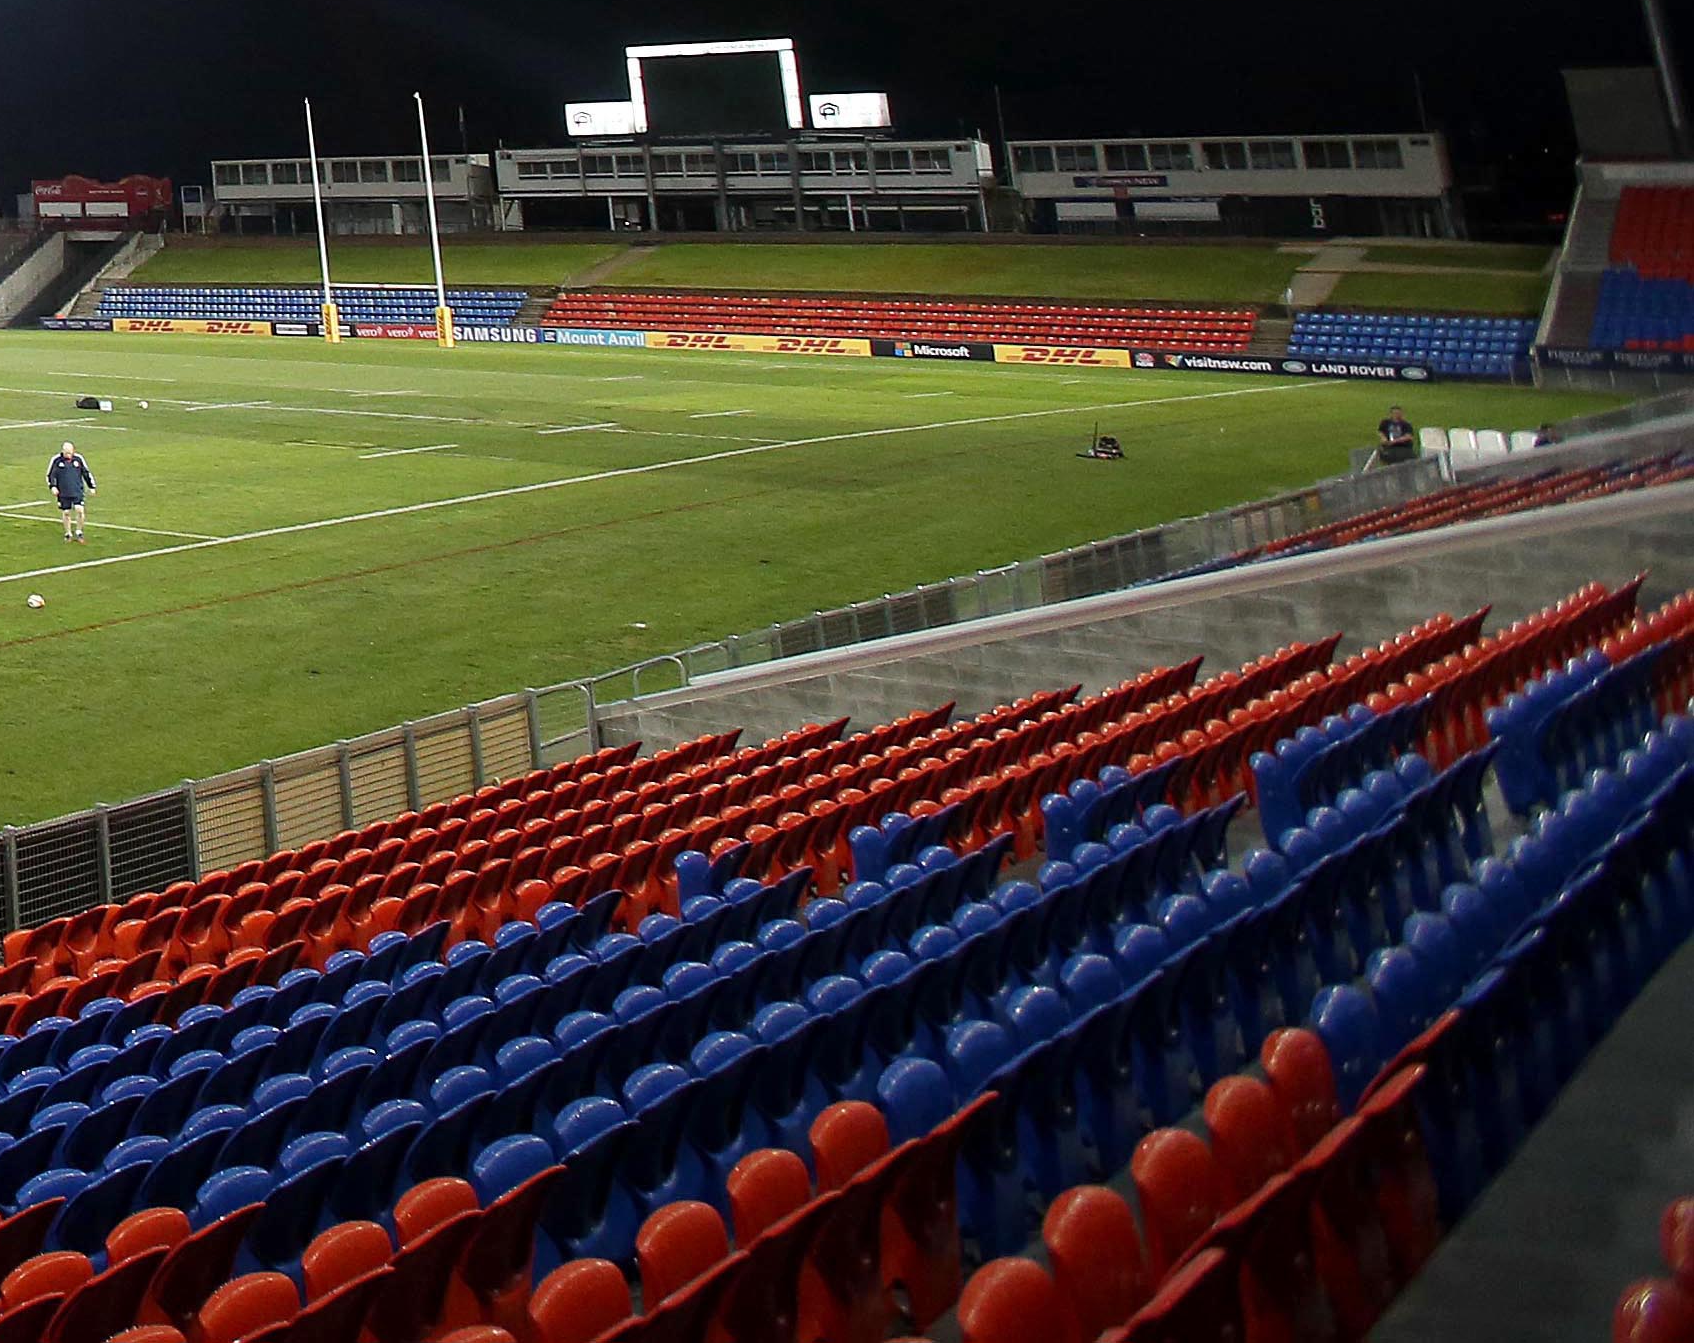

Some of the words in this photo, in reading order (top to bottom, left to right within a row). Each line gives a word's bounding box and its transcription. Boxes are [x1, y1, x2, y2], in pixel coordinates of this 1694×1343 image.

[129, 321, 174, 331] DHL
[206, 322, 254, 333] DHL
[453, 326, 537, 343] SAMSUNG
[558, 331, 606, 344] Mount
[609, 332, 645, 347] Anvil
[667, 334, 731, 349] DHL
[777, 338, 846, 354] DHL
[913, 345, 970, 357] Microsoft
[1022, 347, 1102, 364] DHL
[1184, 357, 1272, 371] visitnsw.com
[1312, 363, 1346, 375] LAND
[1350, 365, 1395, 377] ROVER
